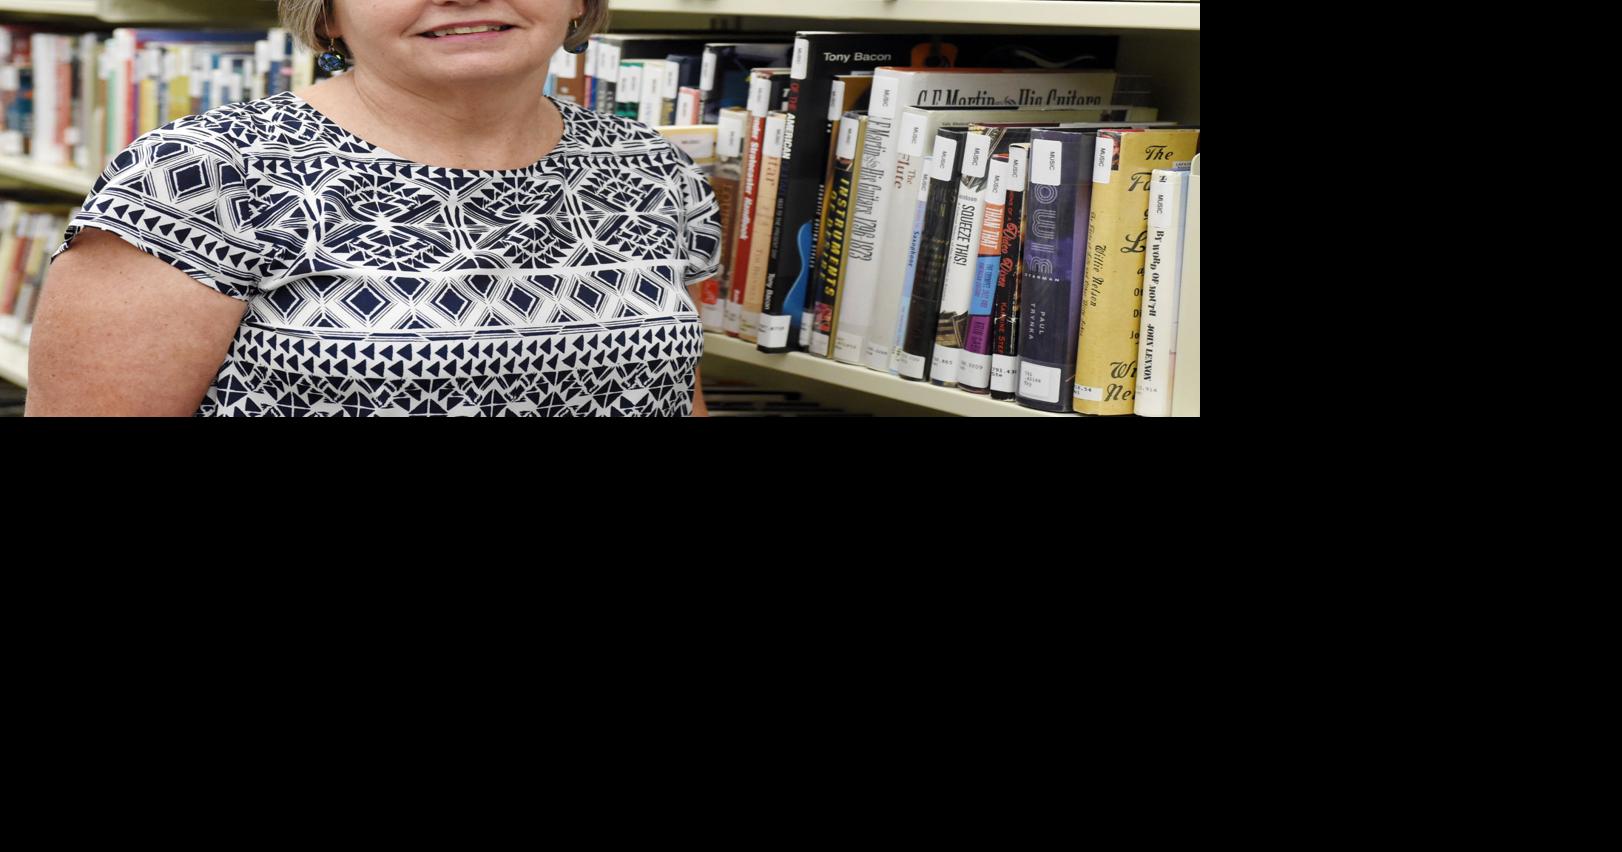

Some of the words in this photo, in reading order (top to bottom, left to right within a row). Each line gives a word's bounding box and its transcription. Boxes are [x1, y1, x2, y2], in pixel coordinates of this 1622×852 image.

[824, 52, 850, 63] Tony
[854, 52, 892, 62] Bacon
[882, 89, 891, 108] MUSIC
[946, 89, 995, 106] Martin
[782, 113, 796, 160] AMERICAN
[863, 128, 891, 158] Martin
[911, 126, 919, 144] MUSIC
[940, 150, 948, 169] MUSIC
[971, 147, 980, 166] MUSIC
[1048, 151, 1056, 171] MUSIC
[1097, 147, 1106, 168] MUSIC
[1145, 145, 1174, 161] The
[859, 167, 885, 183] His
[906, 170, 917, 185] The
[1011, 158, 1019, 178] MUSIC
[920, 173, 928, 192] MUSIC
[991, 174, 1000, 194] MUSIC
[1156, 194, 1164, 215] MUSIC
[957, 204, 976, 243] SQUEEZE
[983, 206, 1005, 230] THAN
[824, 178, 849, 298] INSTRUMENTS
[849, 216, 878, 262] 1796-1873
[1000, 222, 1019, 254] Video
[1030, 184, 1058, 274] OWIE
[907, 230, 920, 268] Saxophone
[980, 230, 1001, 250] THAT
[952, 243, 969, 267] THIS!
[1093, 244, 1107, 273] Willie
[766, 273, 776, 289] Tony
[998, 257, 1014, 289] Vixen
[1024, 273, 1060, 282] STARMAN
[1152, 271, 1161, 285] OF
[764, 289, 774, 311] Bacon
[1090, 276, 1104, 307] Nelson
[1148, 284, 1157, 317] MOUTH
[1029, 303, 1037, 340] TRYNKA
[1038, 311, 1046, 335] PAUL
[1145, 323, 1156, 348] JOHN
[1143, 348, 1153, 381] LENNON
